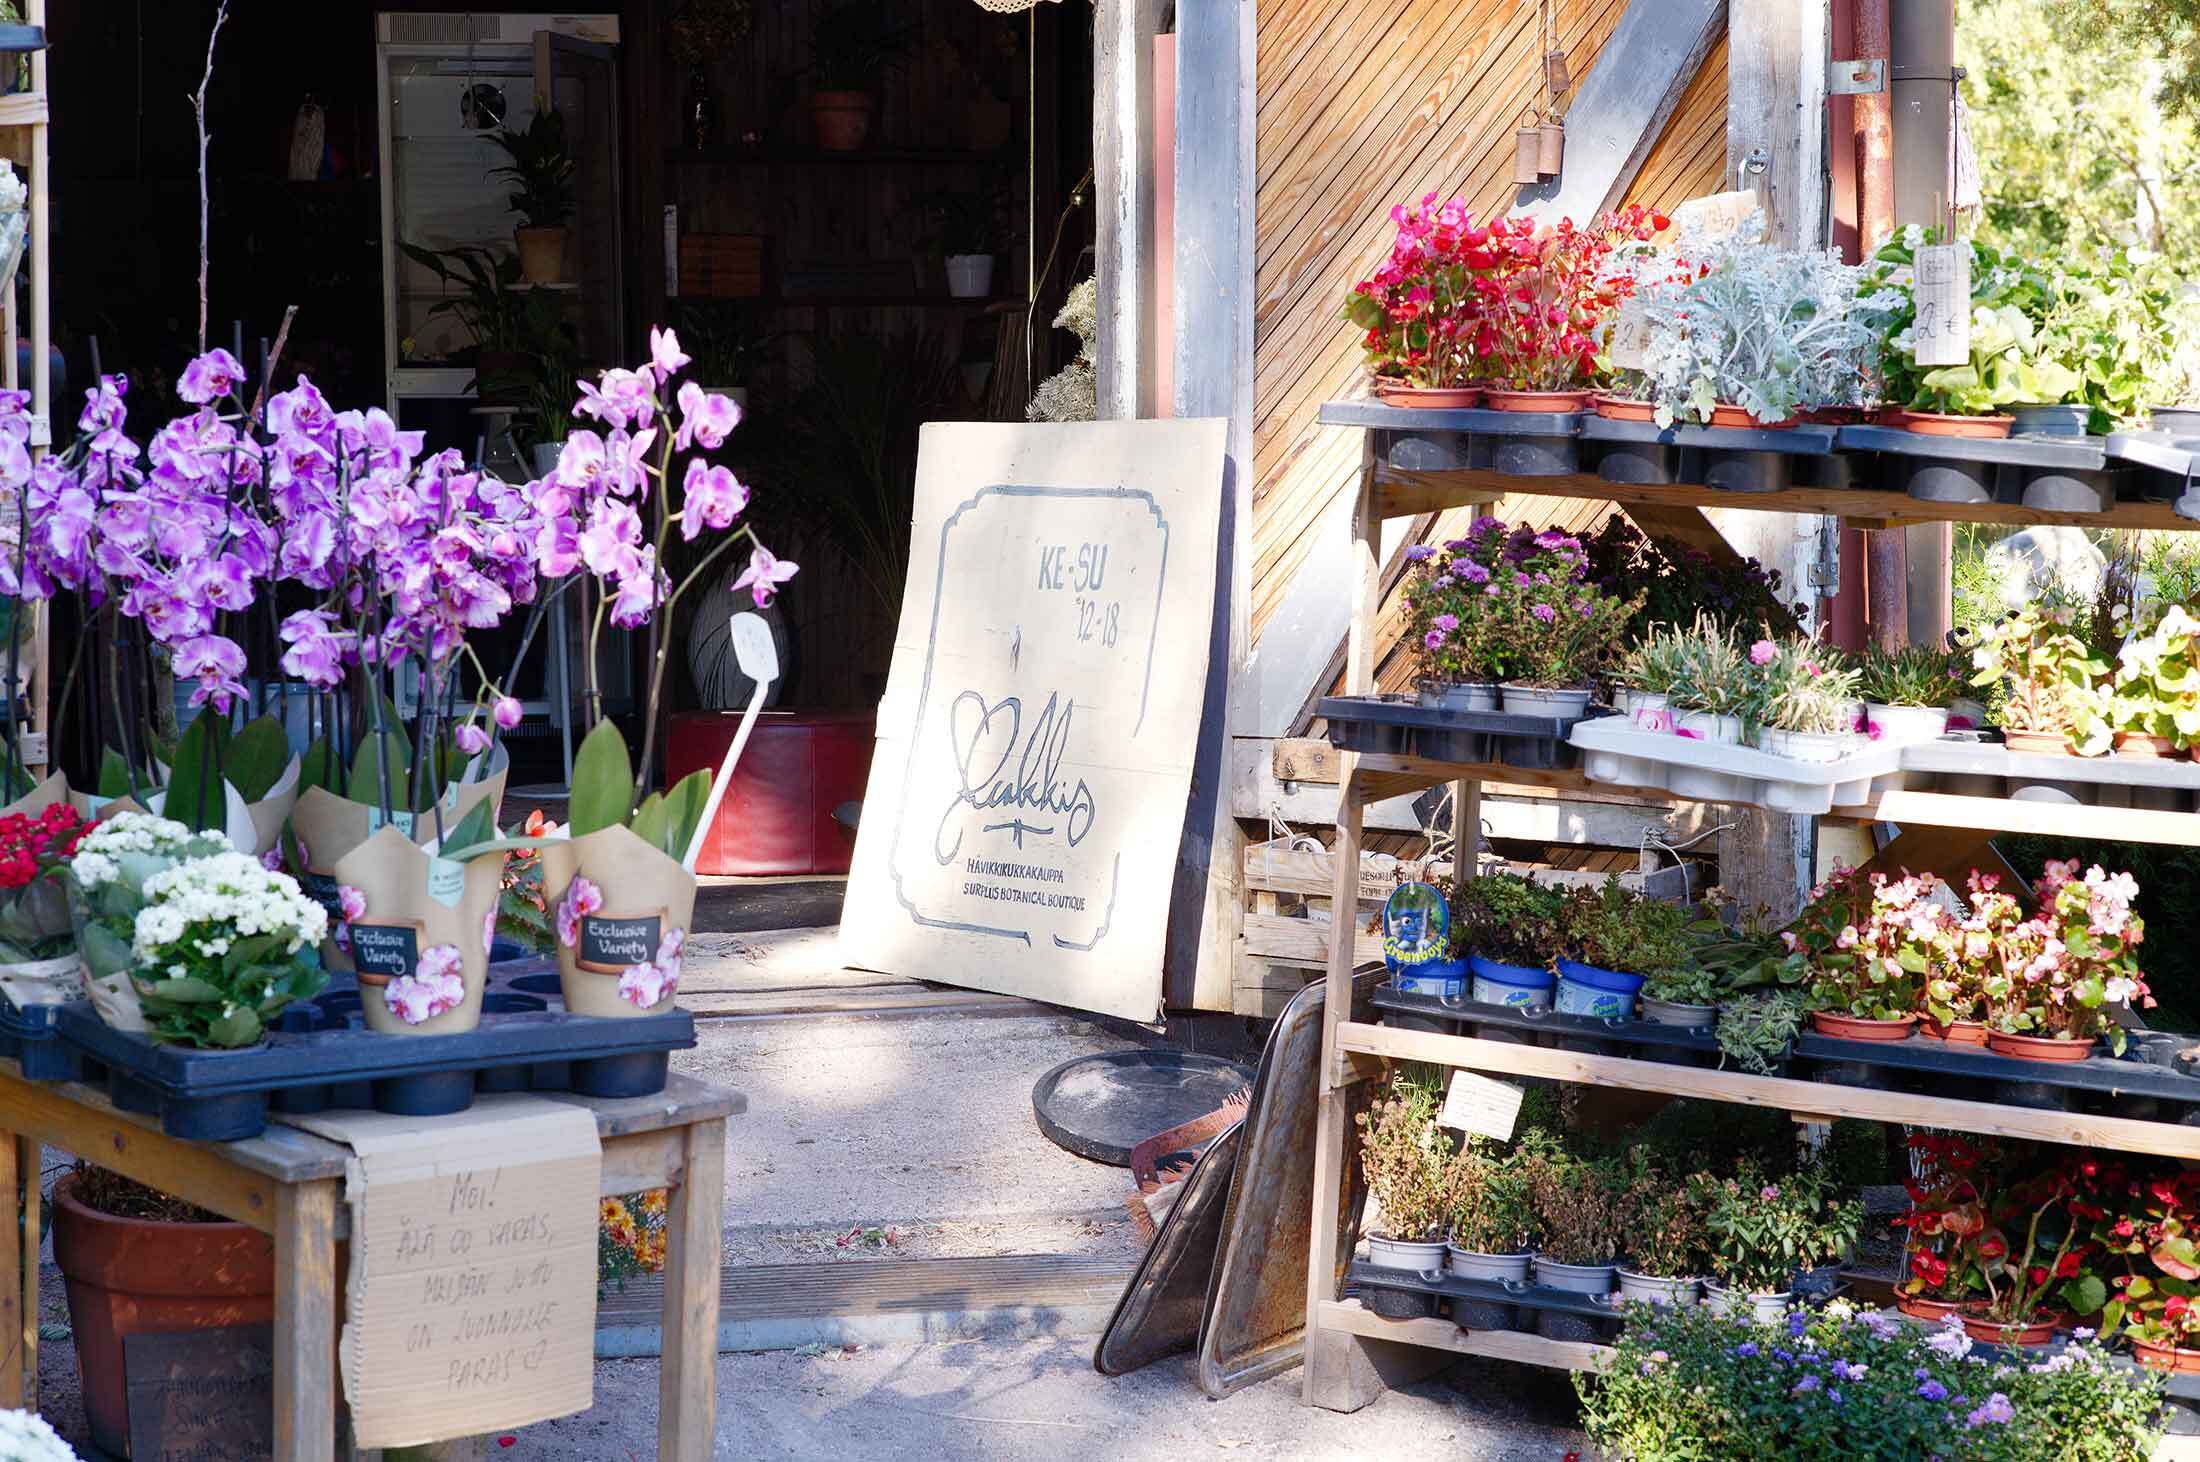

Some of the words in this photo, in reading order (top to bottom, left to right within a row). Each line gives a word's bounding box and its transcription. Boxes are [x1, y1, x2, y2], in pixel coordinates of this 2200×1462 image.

[963, 882, 999, 901] SURPLUS
[1000, 887, 1047, 907] BOTANICAL
[1048, 893, 1086, 912] BOUTIQUE
[355, 928, 405, 946] Exclusive
[589, 921, 648, 939] Exclusive
[363, 946, 406, 975] Variety
[598, 938, 648, 962] Variety
[1383, 935, 1448, 963] Greenboys
